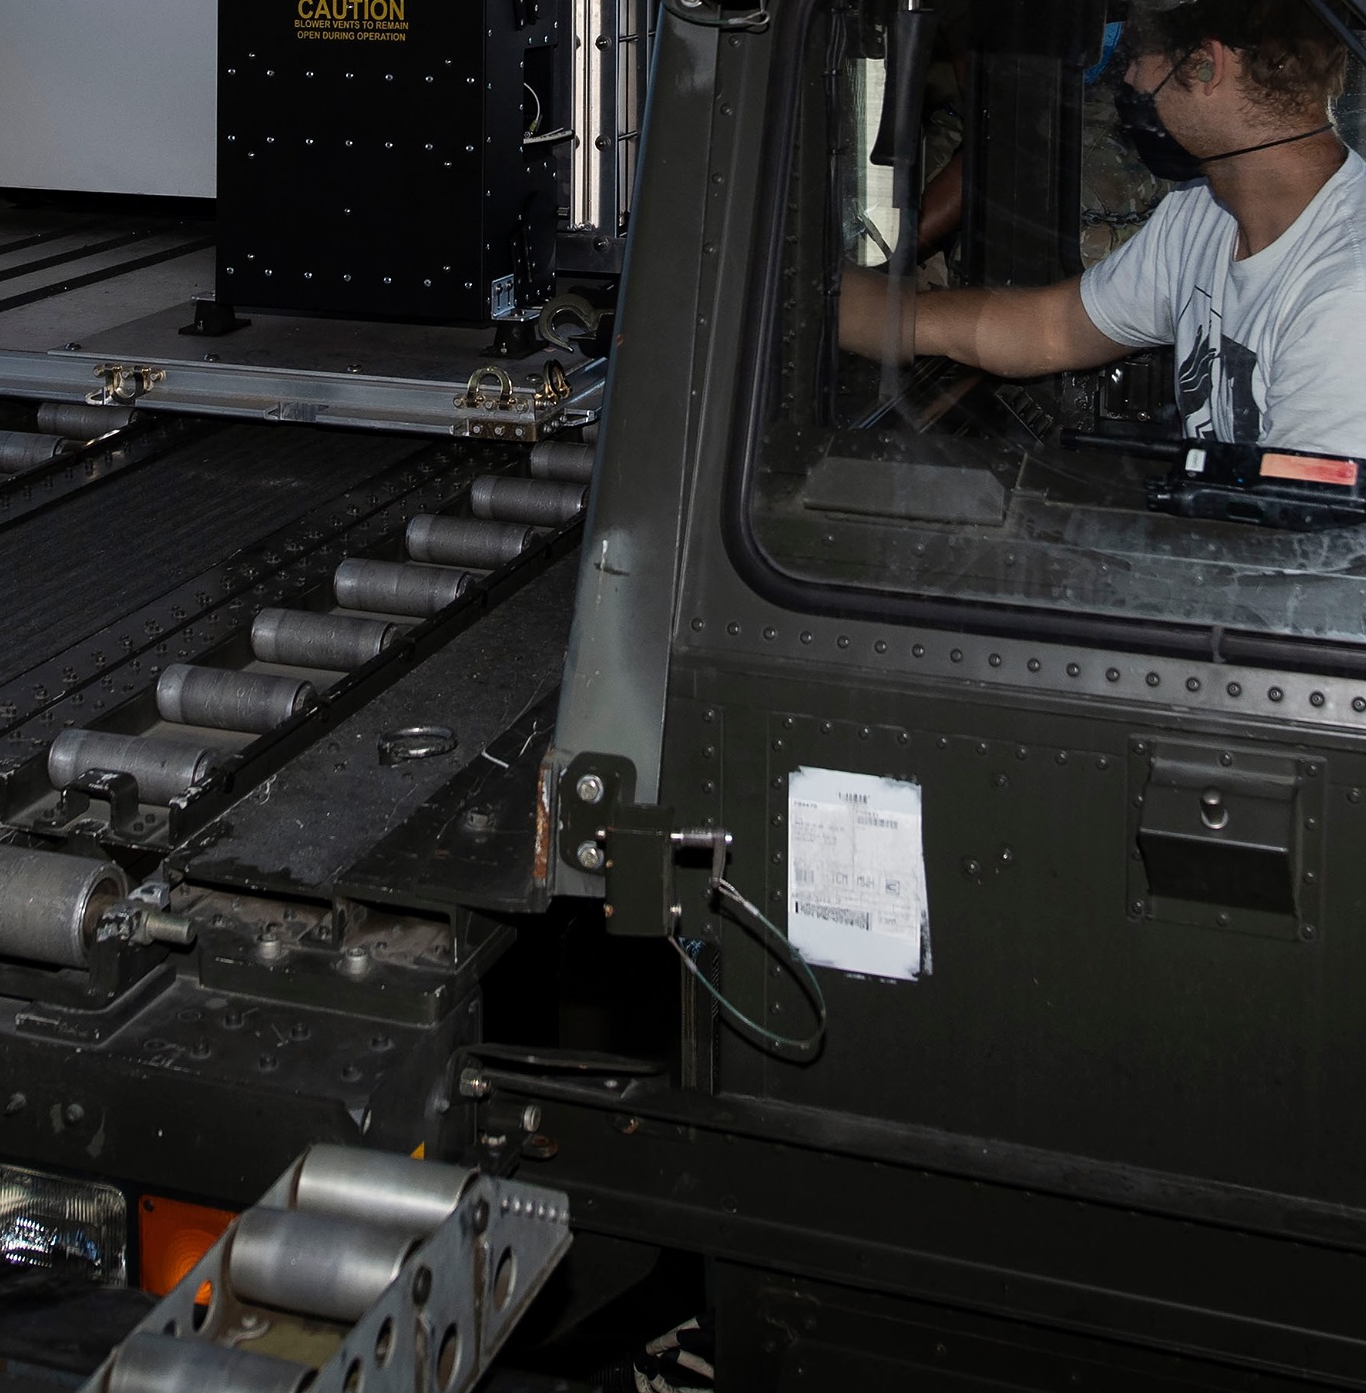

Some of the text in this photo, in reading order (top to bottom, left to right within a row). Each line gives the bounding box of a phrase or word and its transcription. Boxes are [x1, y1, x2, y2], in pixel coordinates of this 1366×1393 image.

[294, 19, 409, 30] BLOWER VENTS TO REMAIN
[297, 30, 406, 41] OPEN DURING OPERATION
